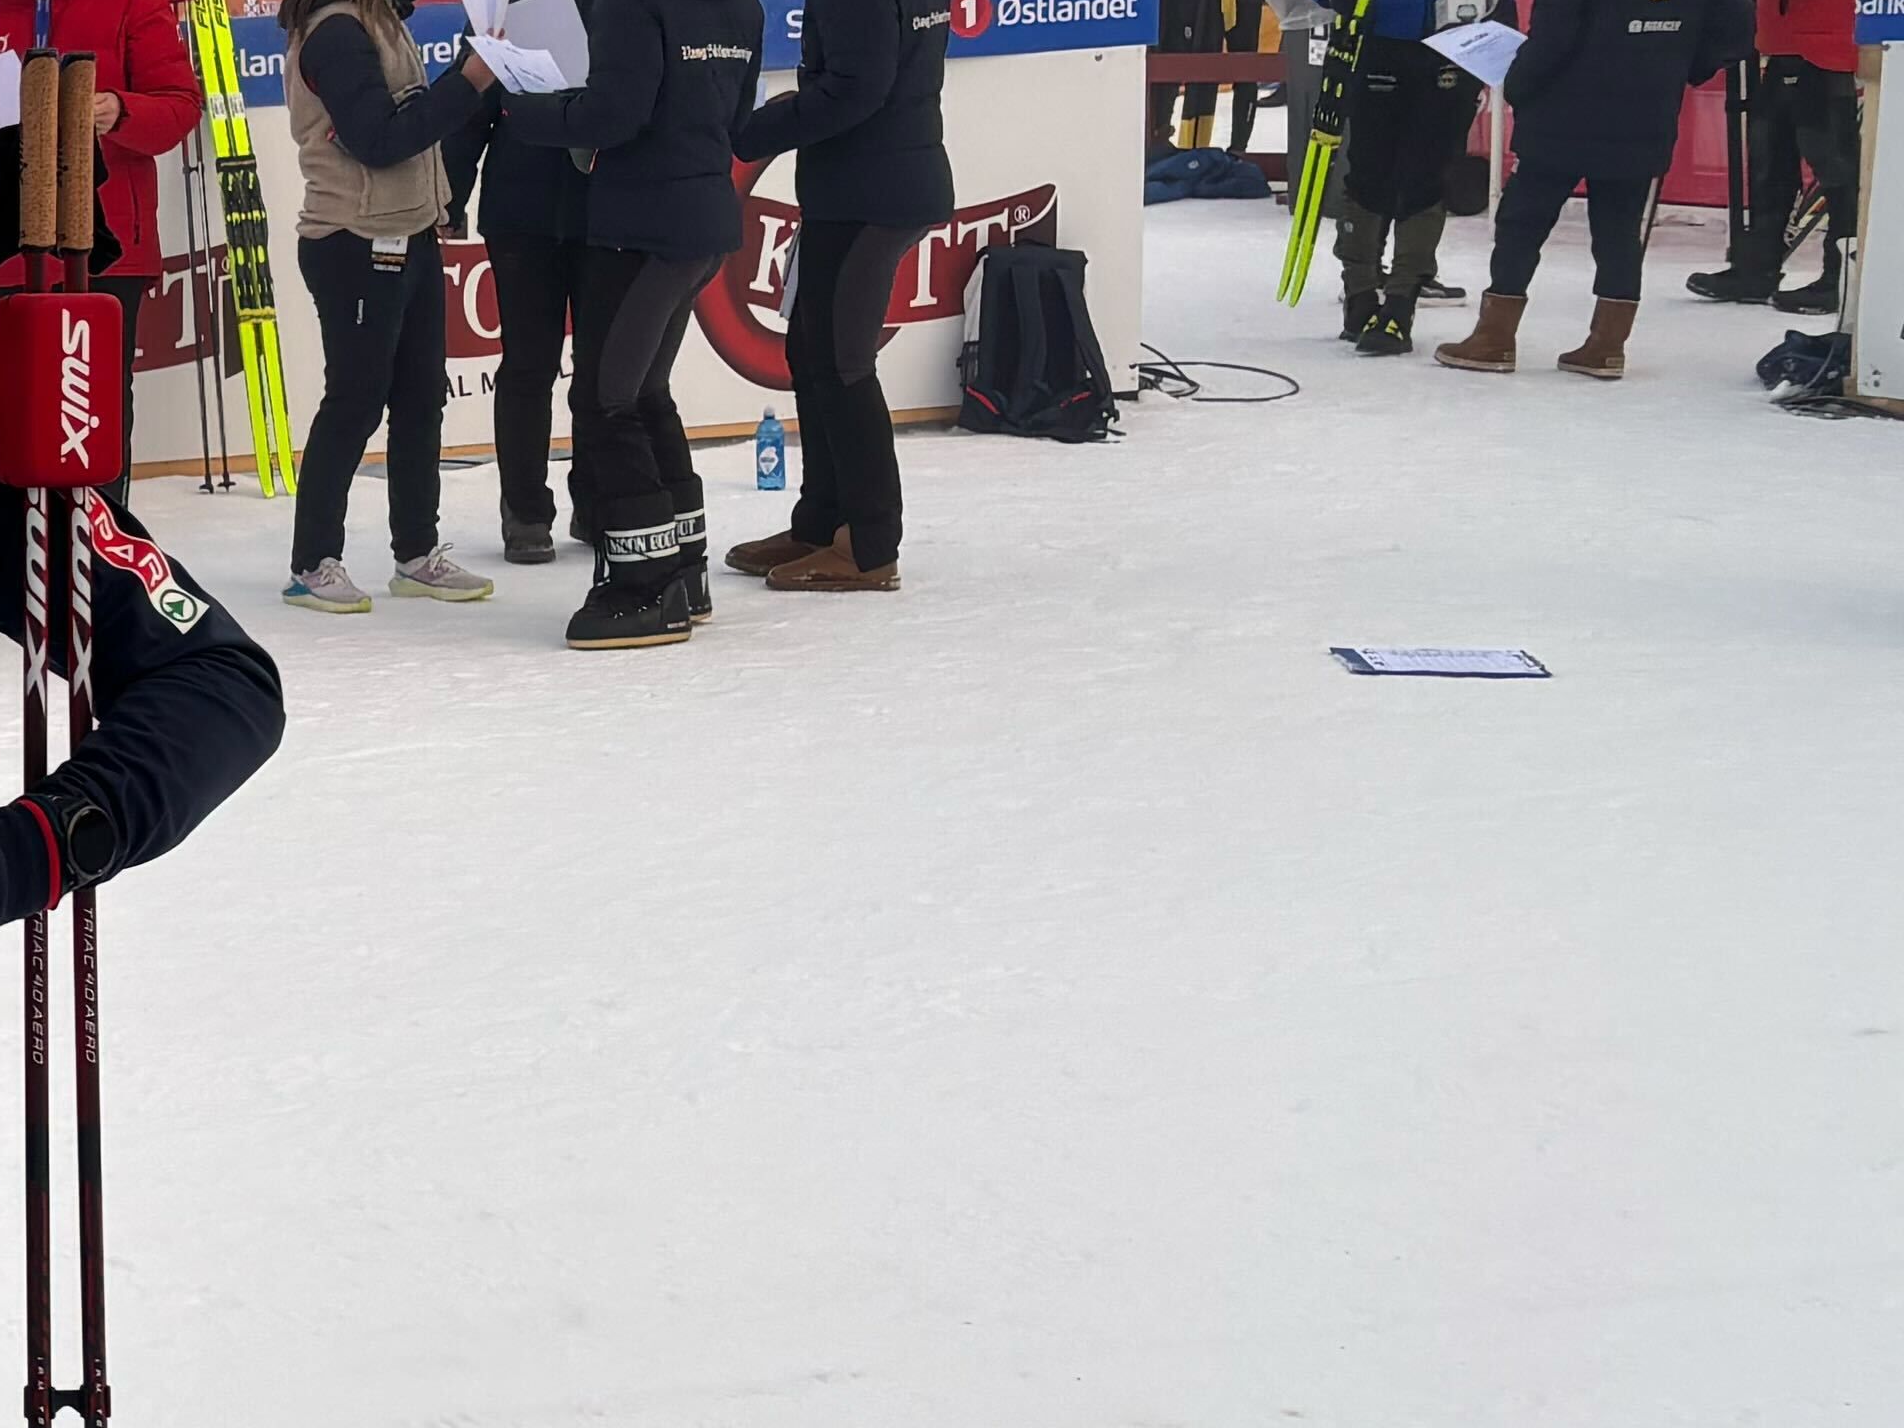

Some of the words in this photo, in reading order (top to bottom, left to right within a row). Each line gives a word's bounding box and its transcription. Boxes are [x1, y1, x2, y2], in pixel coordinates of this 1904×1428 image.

[31, 911, 44, 971] TRIAC
[82, 907, 96, 969] TRIAC
[32, 1004, 45, 1065] AERO
[84, 1003, 97, 1063] AERO
